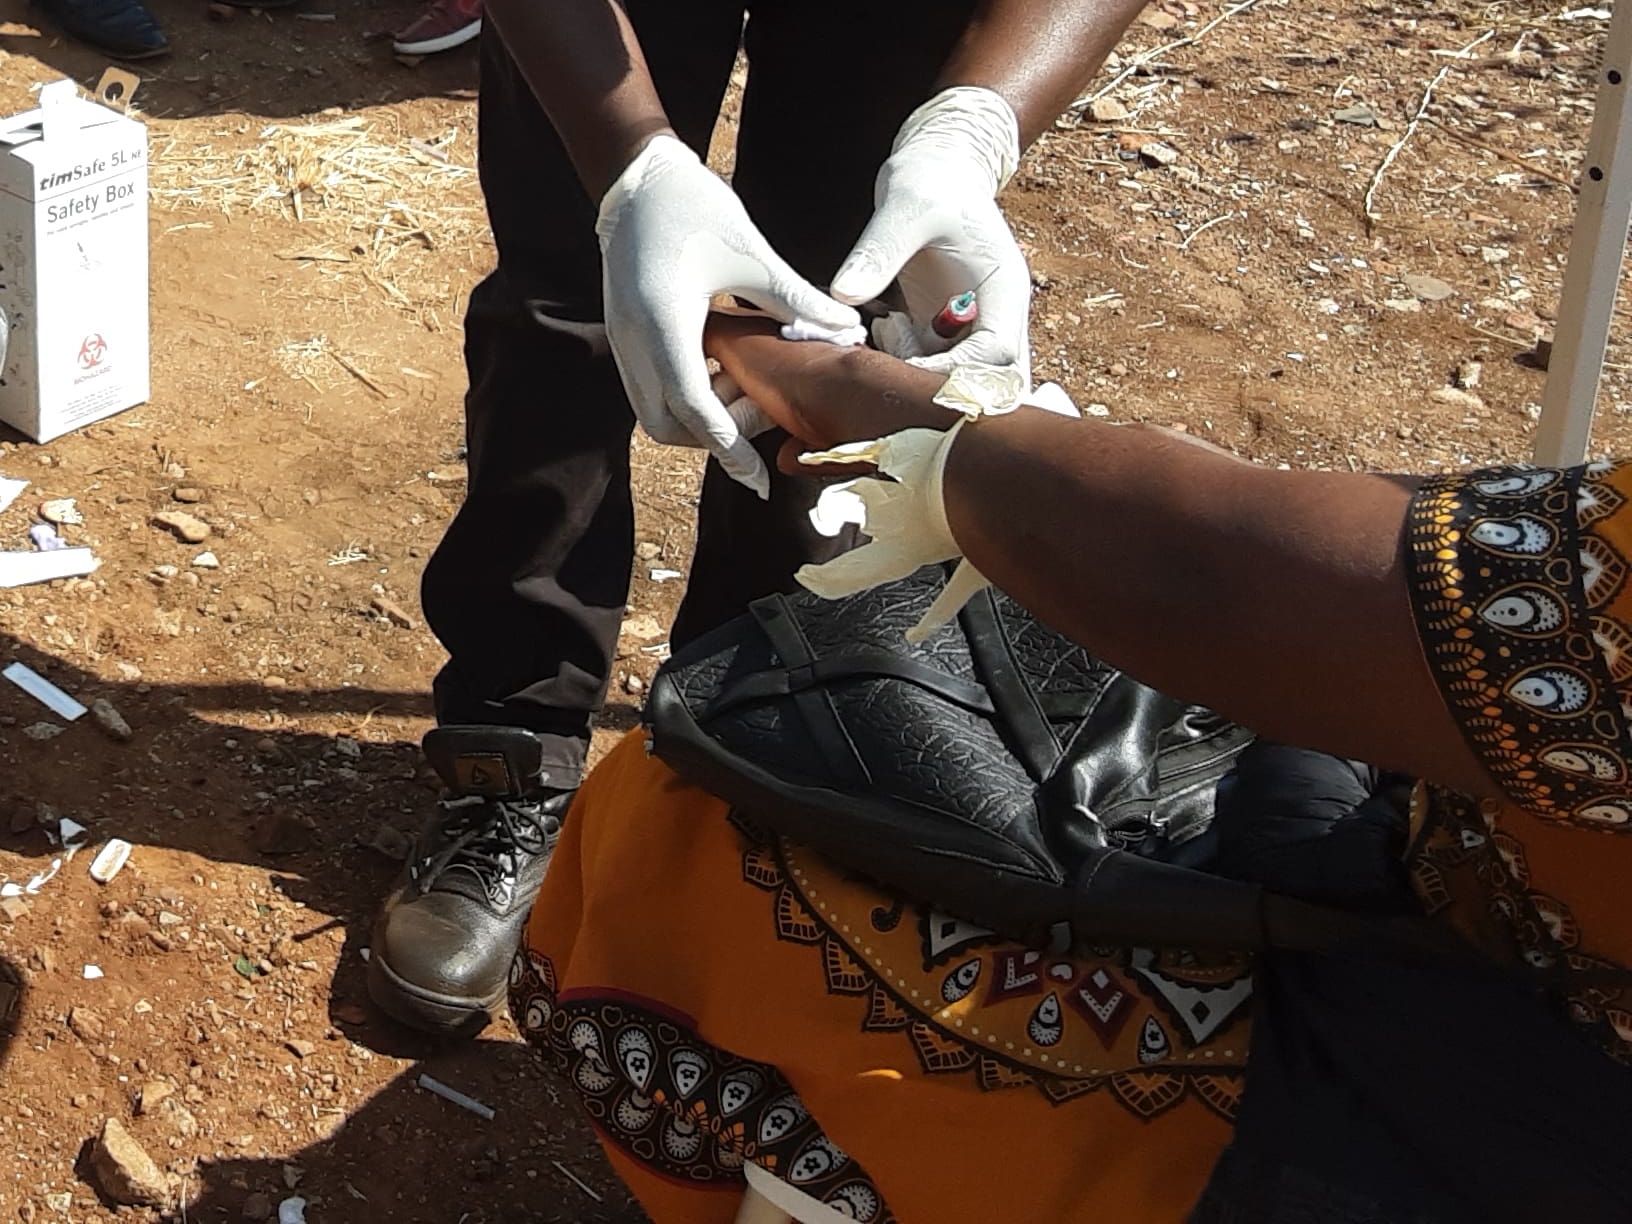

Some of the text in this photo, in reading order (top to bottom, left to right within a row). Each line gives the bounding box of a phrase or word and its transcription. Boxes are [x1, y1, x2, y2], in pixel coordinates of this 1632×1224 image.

[111, 150, 128, 169] 5L
[46, 179, 135, 224] Safety Box
